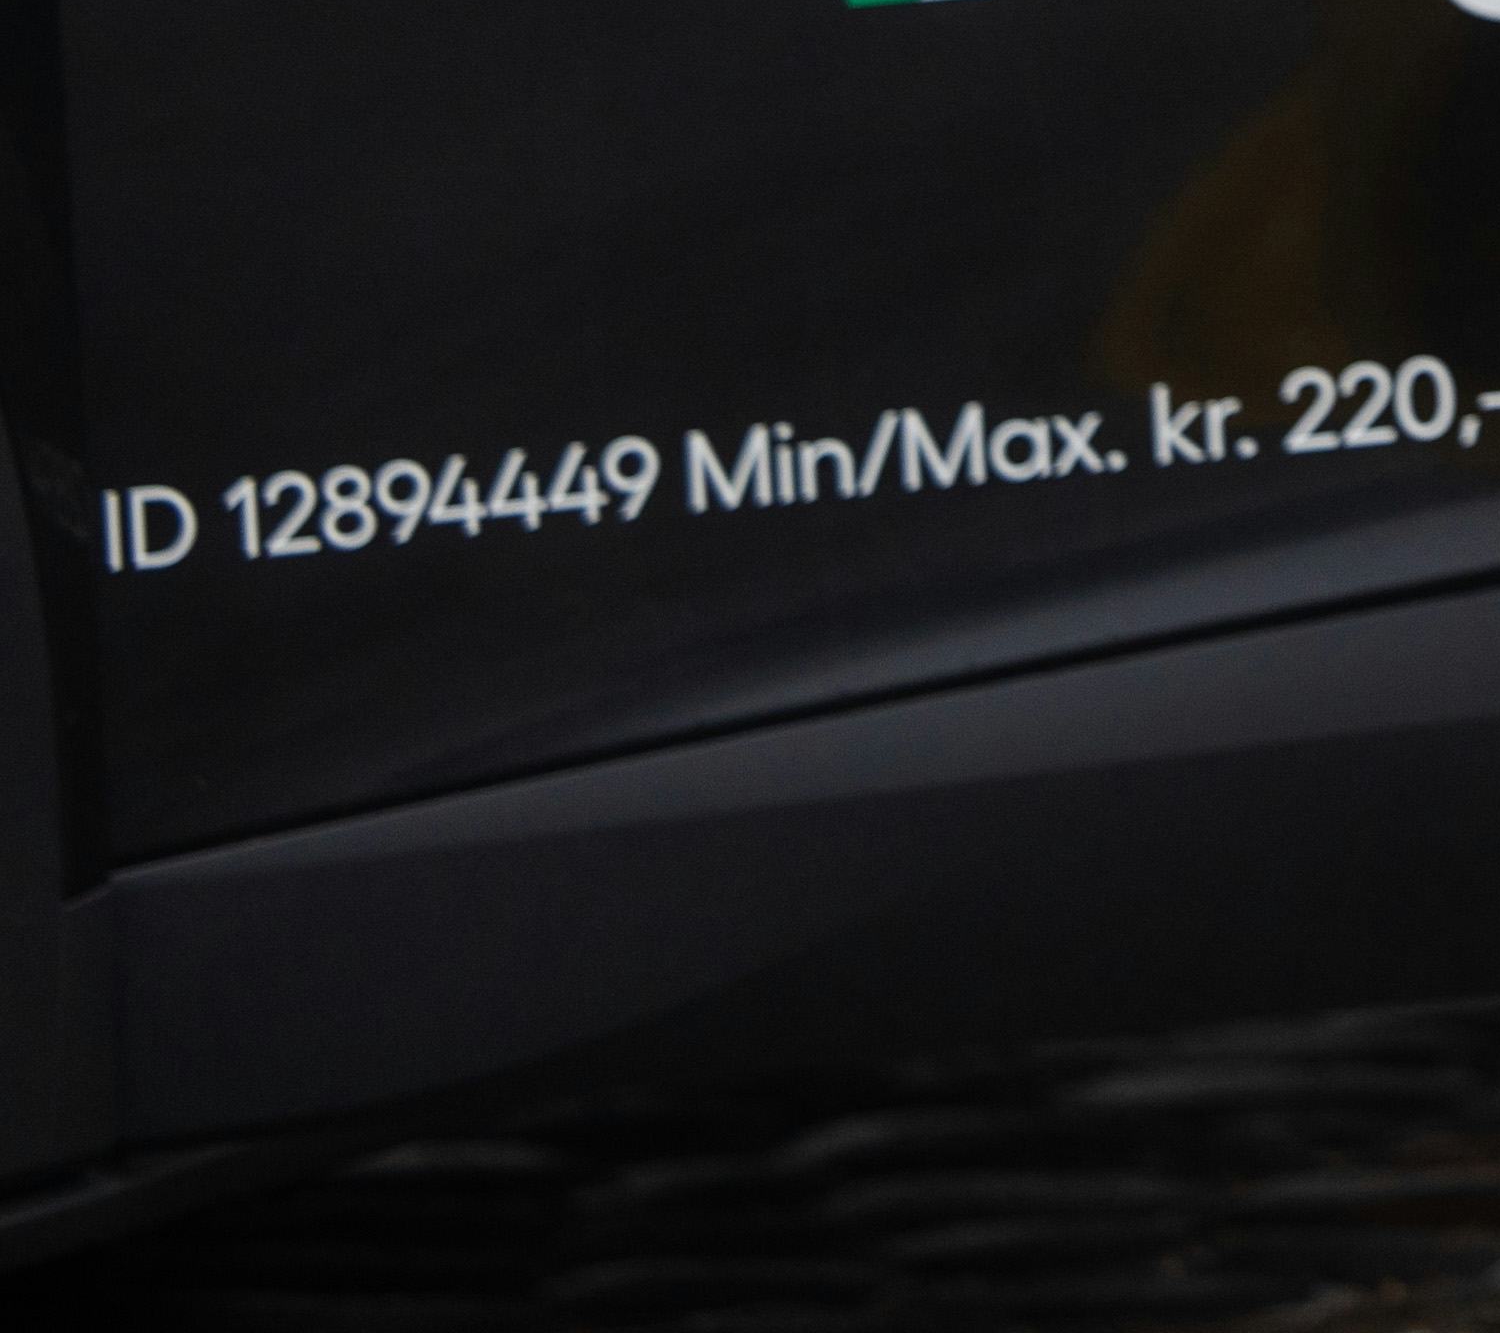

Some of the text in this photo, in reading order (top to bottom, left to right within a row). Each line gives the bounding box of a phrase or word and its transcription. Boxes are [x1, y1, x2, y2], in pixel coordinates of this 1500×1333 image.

[103, 484, 198, 573] ID
[224, 434, 661, 560] 12894449
[685, 400, 1128, 514] Min/Max.
[1150, 381, 1259, 467] kr.
